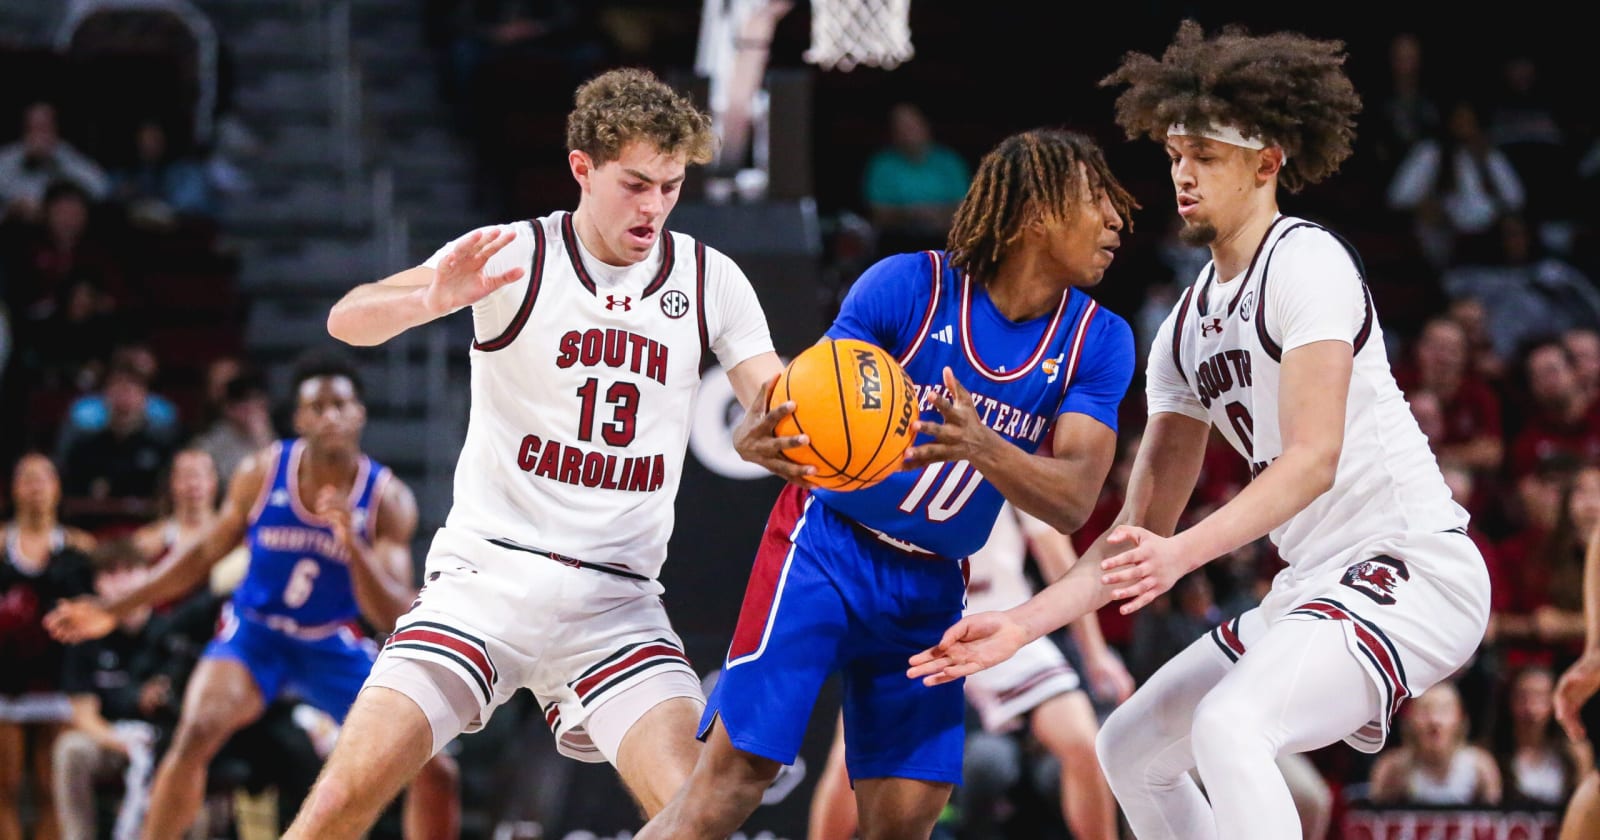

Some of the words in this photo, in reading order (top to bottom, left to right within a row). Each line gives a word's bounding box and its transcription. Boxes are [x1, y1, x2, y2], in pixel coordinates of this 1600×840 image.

[661, 293, 688, 316] SEC
[556, 328, 669, 386] SOUTH
[853, 349, 881, 410] NCAA
[576, 377, 640, 448] 13
[517, 434, 665, 492] CAROLINA
[898, 458, 985, 523] 10
[283, 558, 320, 608] 6
